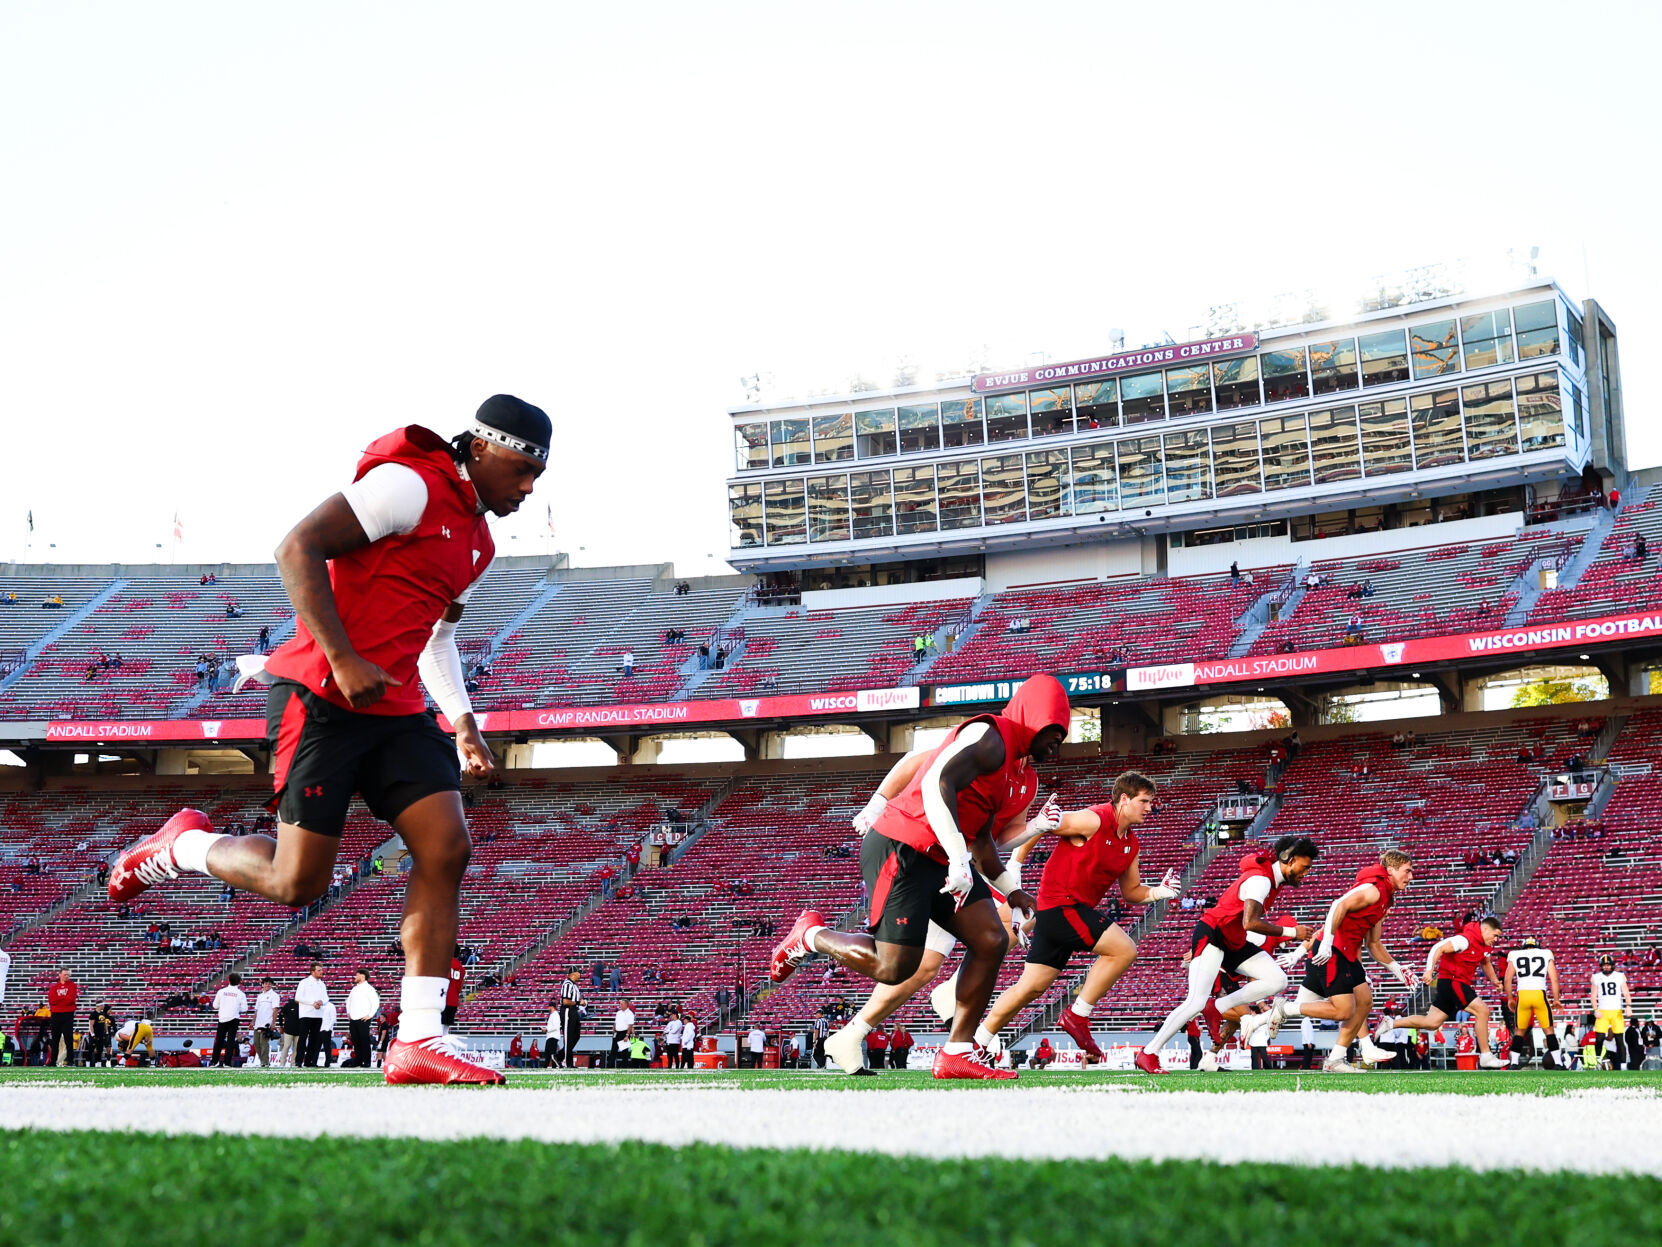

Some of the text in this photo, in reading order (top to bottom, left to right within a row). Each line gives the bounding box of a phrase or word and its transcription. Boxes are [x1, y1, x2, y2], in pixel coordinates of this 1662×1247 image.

[986, 337, 1244, 387] EVJUE COMMUNICATIONS CENTER
[1469, 627, 1572, 651] WISCONSIN
[1253, 656, 1317, 673] STADIUM
[1068, 674, 1112, 691] 75:18
[935, 683, 995, 703] COUNTDOWN
[997, 682, 1010, 699] TO
[538, 707, 687, 725] CAMP RANDALL STADIUM
[47, 725, 151, 737] ANDALL STADIUM
[1580, 783, 1588, 793] G
[1226, 807, 1233, 816] E
[657, 833, 663, 841] C
[1516, 956, 1546, 978] 92
[1601, 981, 1617, 996] 18
